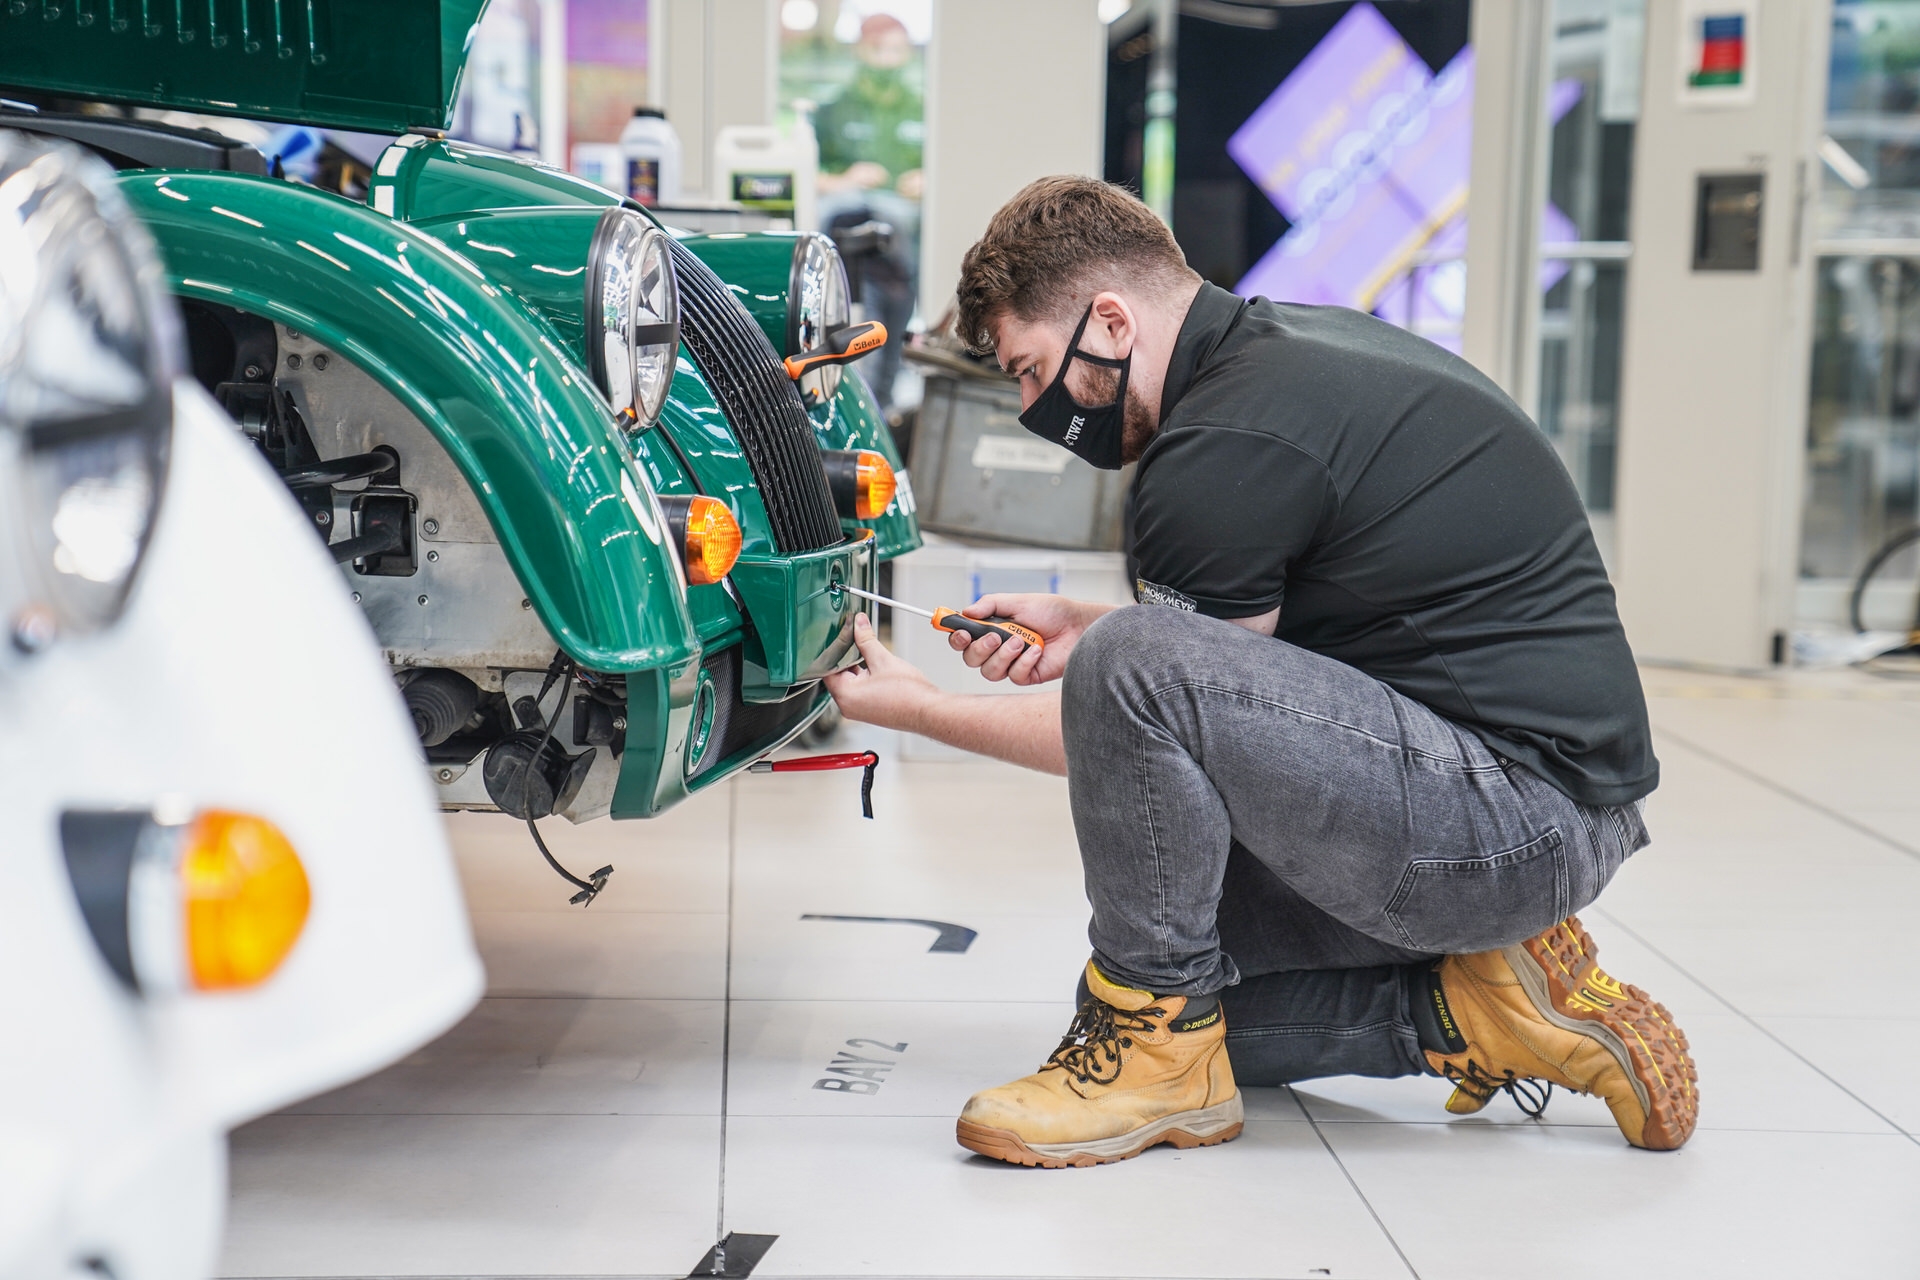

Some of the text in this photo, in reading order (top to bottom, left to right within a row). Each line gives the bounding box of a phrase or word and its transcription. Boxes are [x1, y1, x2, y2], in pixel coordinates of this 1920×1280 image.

[861, 338, 881, 349] Beta
[1065, 415, 1086, 441] UWR
[1015, 627, 1036, 643] Beta
[1433, 989, 1453, 1030] DUNLOP
[1190, 1012, 1218, 1030] DUNLOP
[811, 1038, 909, 1096] BAY 2
